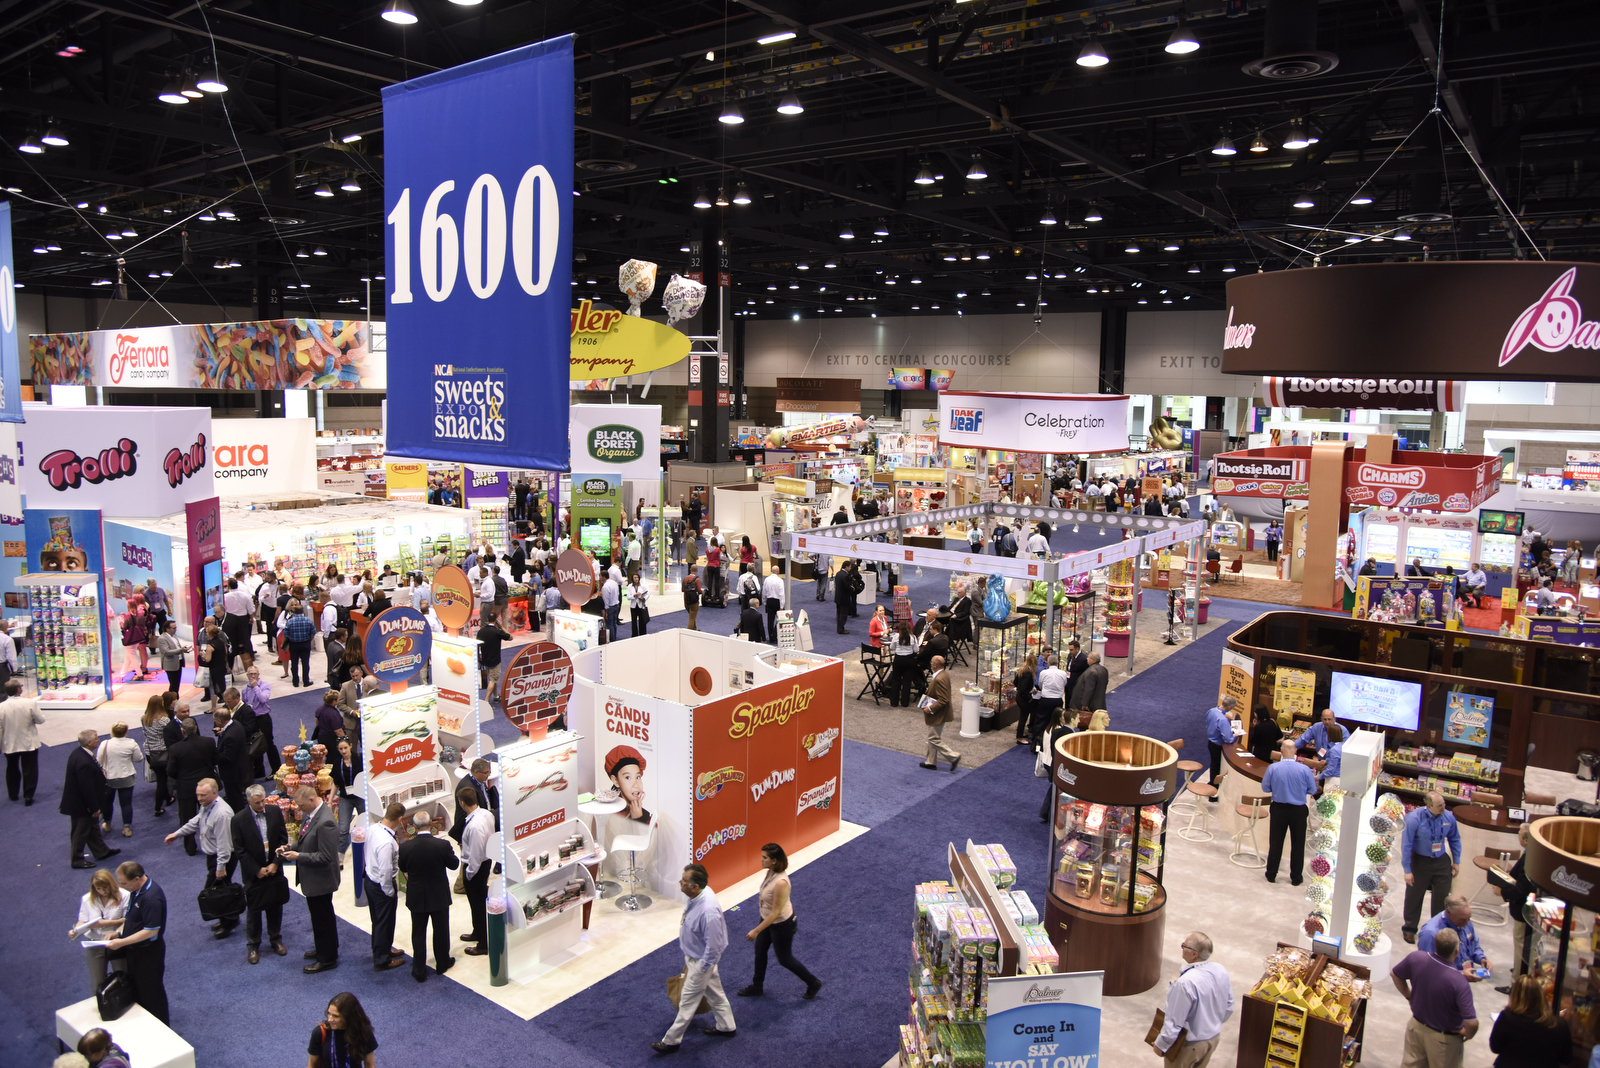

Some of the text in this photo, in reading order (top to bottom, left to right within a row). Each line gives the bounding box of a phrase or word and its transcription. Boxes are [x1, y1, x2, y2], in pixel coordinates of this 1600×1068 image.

[388, 164, 560, 304] 1600
[691, 258, 701, 267] 32
[720, 258, 729, 268] 32
[577, 337, 598, 346] 1906
[109, 333, 170, 385] Ferrara
[827, 355, 1011, 366] EXIT TO CENTRAL CONCOURSE
[1160, 355, 1221, 369] EXIT TO
[130, 370, 170, 380] candy company
[434, 363, 454, 376] NCA
[434, 375, 505, 406] sweets
[435, 403, 479, 416] EXPO
[489, 395, 503, 420] &
[954, 409, 974, 417] OAK
[434, 403, 506, 442] snacks
[1023, 412, 1105, 429] Celebration
[595, 430, 634, 440] BLACK
[791, 421, 848, 443] SMARTIES
[1059, 429, 1078, 440] FREY
[593, 440, 638, 450] FOREST
[163, 432, 207, 489] Trolli
[212, 444, 269, 468] ara
[597, 447, 636, 460] Organic
[38, 437, 138, 491] Trolli
[393, 464, 420, 472] SATHERS
[1217, 462, 1291, 476] Tootsie Roll
[214, 468, 269, 480] company
[1362, 468, 1421, 485] CHARMS
[472, 477, 499, 488] LATER
[1405, 491, 1439, 507] Andes
[121, 543, 152, 570] BRACH'S
[557, 567, 592, 585] DUM-DUMS
[378, 616, 426, 636] DUM-DUMS
[1229, 666, 1245, 680] Have
[1231, 675, 1242, 687] You
[511, 671, 567, 697] Spangler
[1226, 681, 1248, 698] Heard?
[605, 702, 650, 727] CANDY
[729, 684, 816, 738] Spangler
[606, 718, 650, 743] CANES
[394, 743, 414, 755] NEW
[385, 751, 423, 767] FLAVORS
[721, 769, 745, 786] PEANUTS
[750, 768, 796, 803] DUM-DUMS
[800, 780, 837, 808] Spangler
[515, 825, 530, 837] WE
[1013, 1020, 1076, 1036] Come In
[1033, 1034, 1055, 1044] and
[1027, 1043, 1060, 1058] SAY
